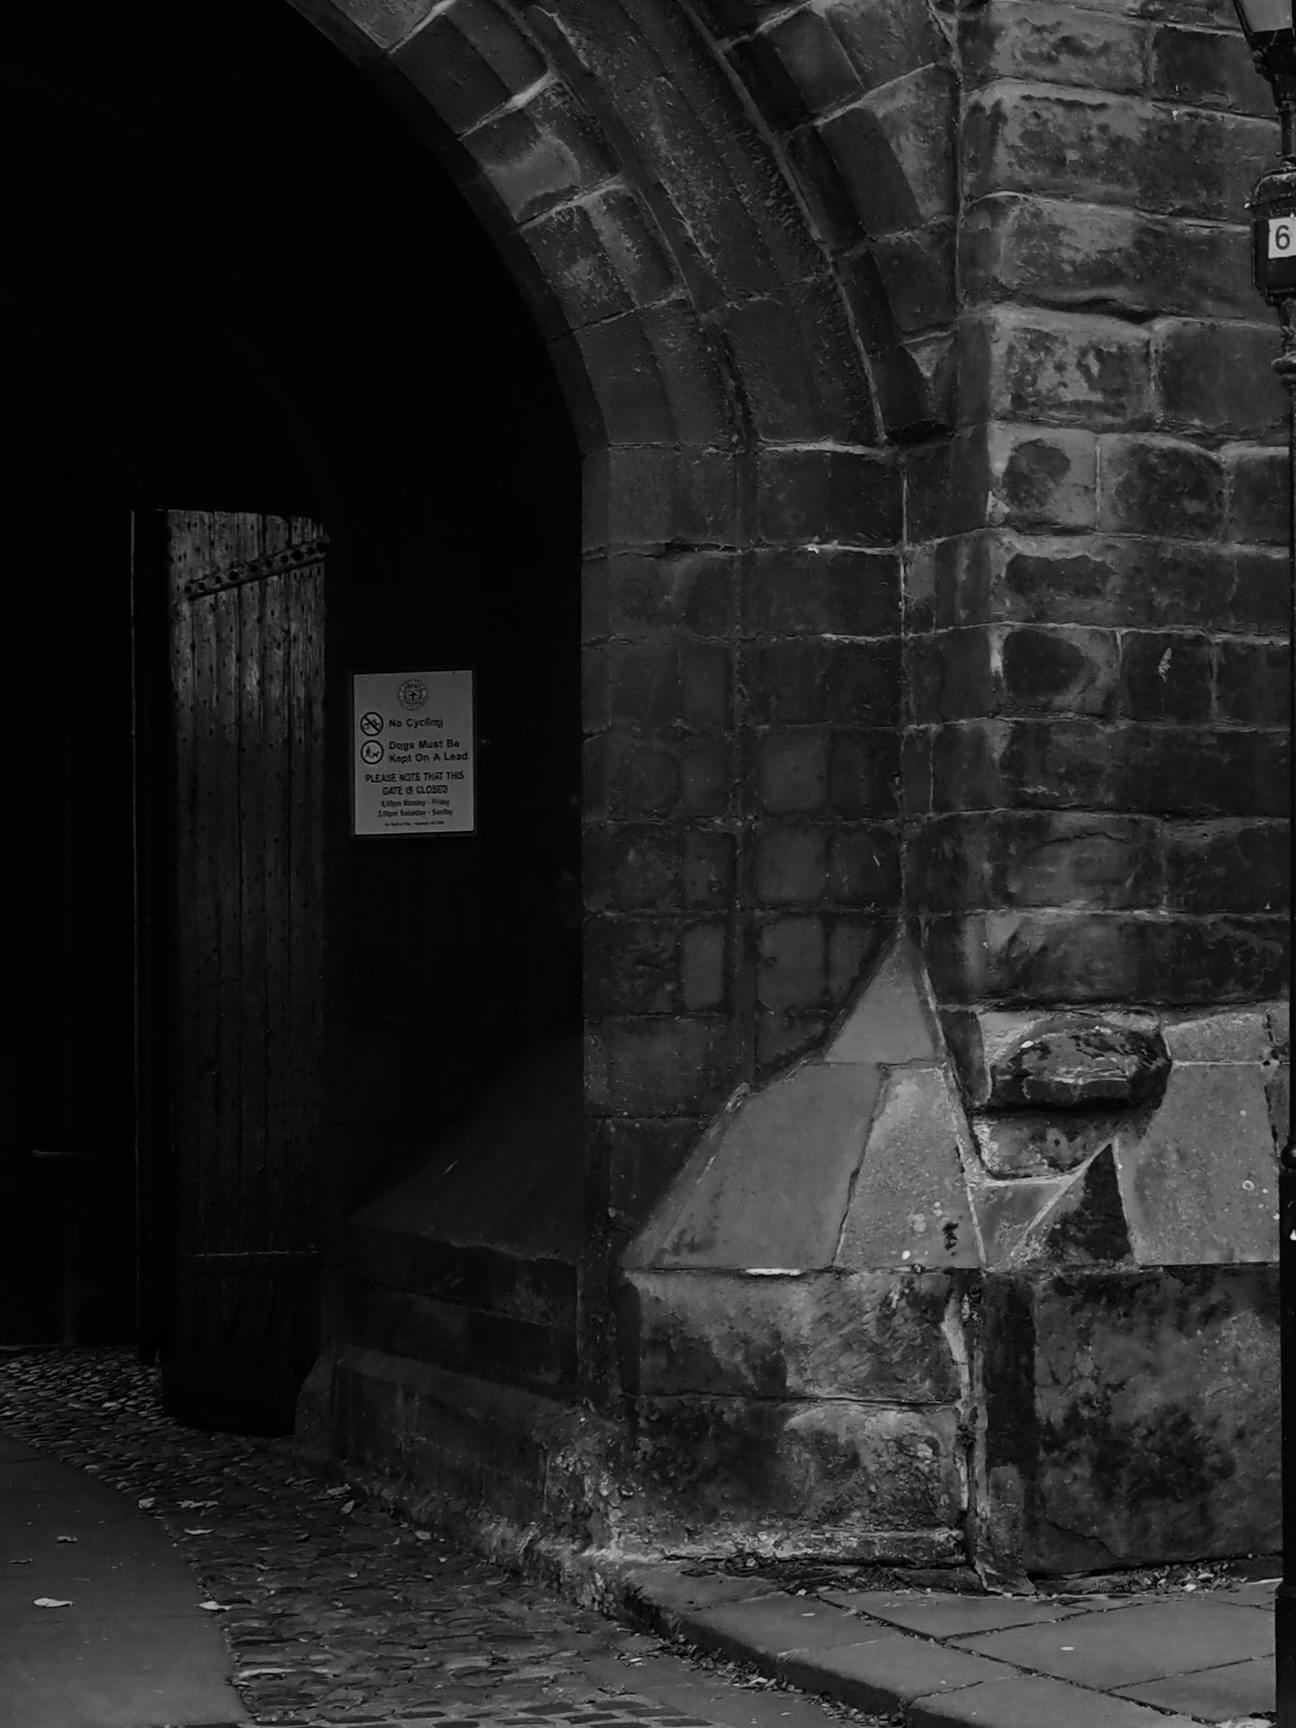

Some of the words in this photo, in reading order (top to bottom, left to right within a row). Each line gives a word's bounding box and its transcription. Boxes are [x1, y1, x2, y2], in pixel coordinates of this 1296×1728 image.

[1275, 224, 1291, 250] 6
[388, 718, 403, 728] No
[406, 717, 444, 729] Cycling
[388, 740, 416, 752] Dogs
[418, 739, 443, 749] Must
[446, 738, 461, 748] Be
[388, 753, 413, 764] Kept
[415, 752, 430, 762] On
[444, 751, 469, 761] Lead
[365, 773, 397, 783] PLEASE
[399, 772, 421, 782] NOTE
[423, 771, 444, 782] THAT
[446, 770, 465, 780] THIS
[382, 786, 403, 796] GATE
[415, 784, 448, 795] CLOSED
